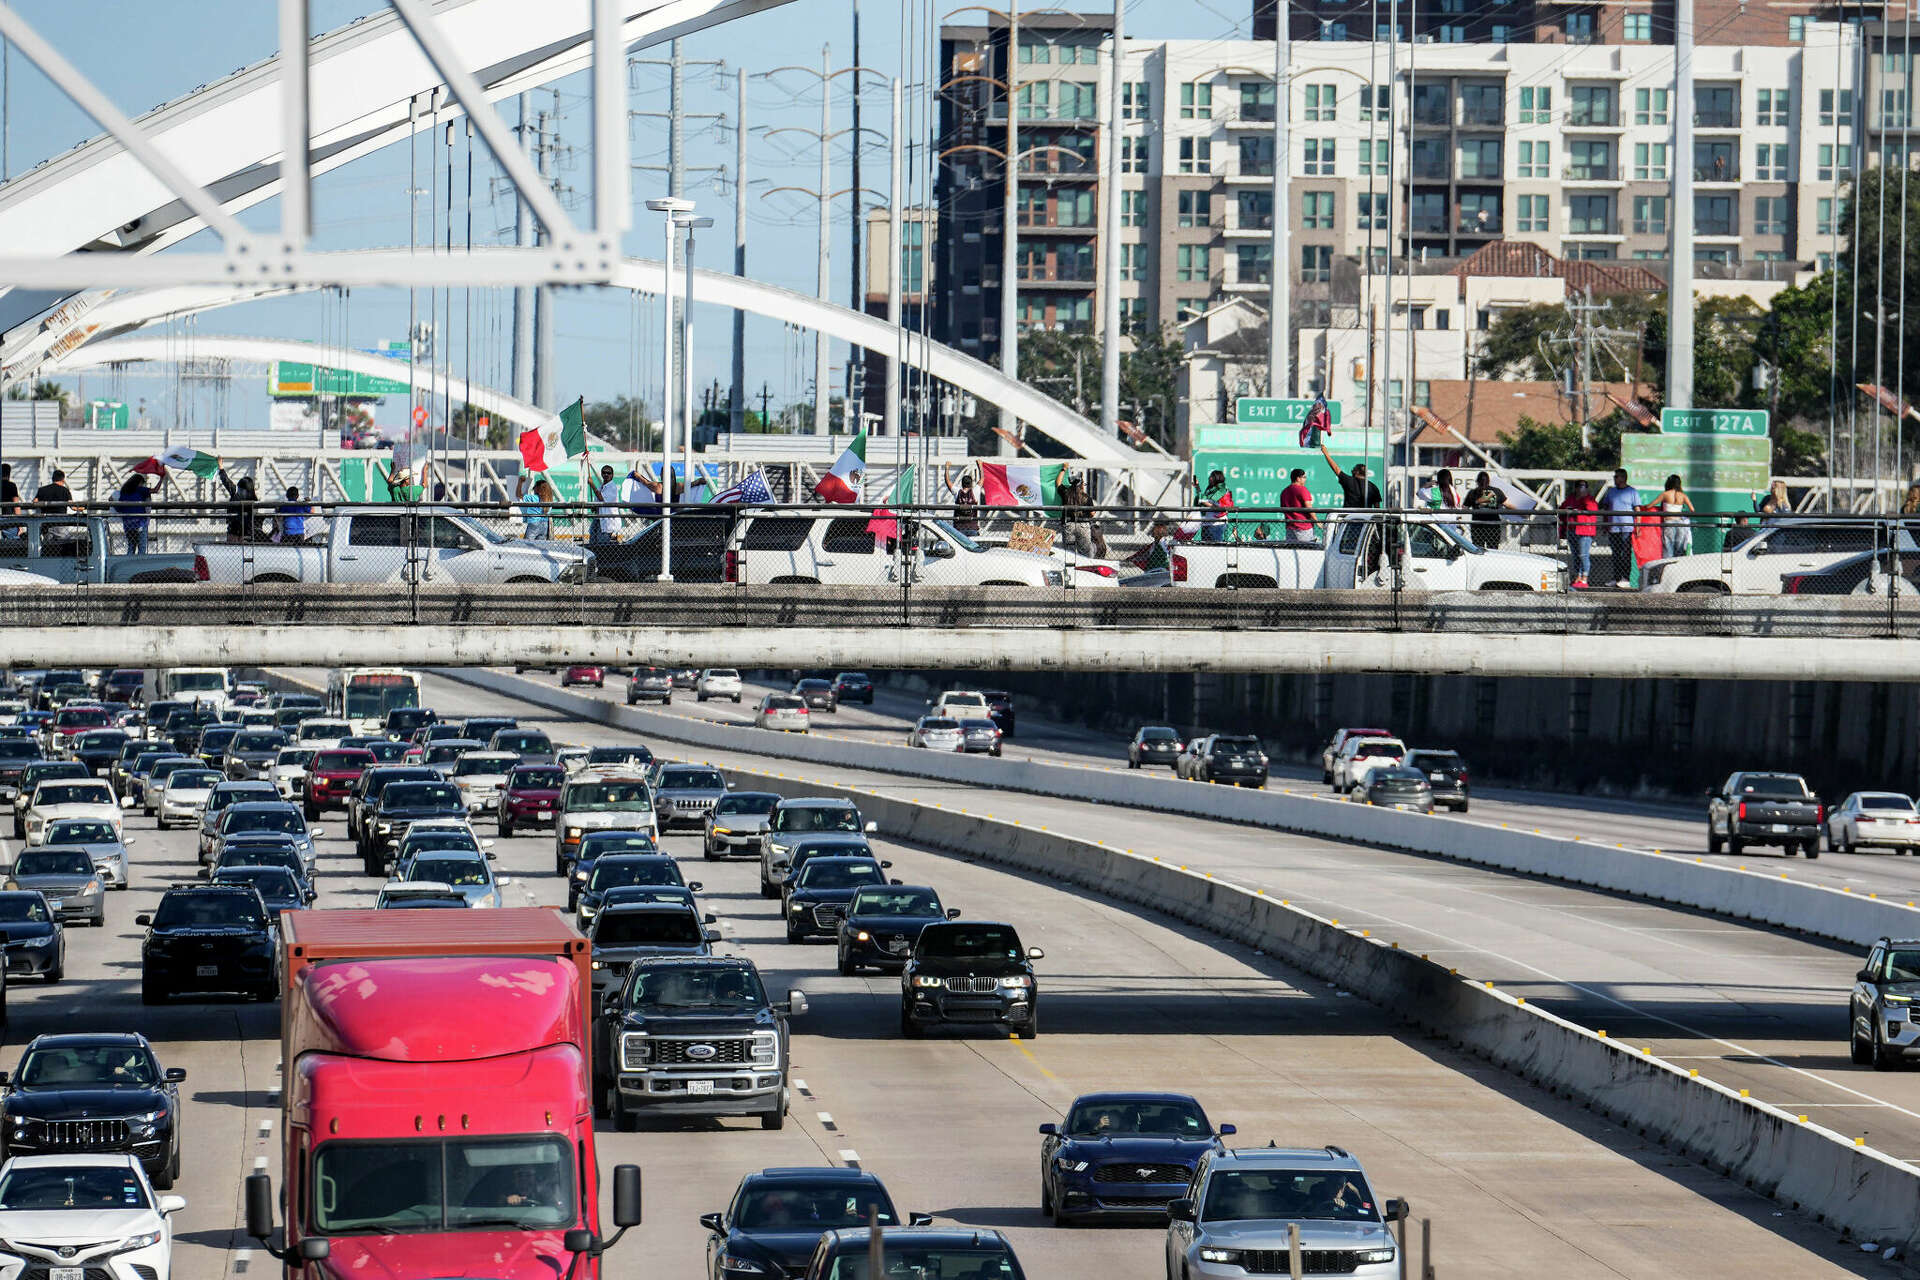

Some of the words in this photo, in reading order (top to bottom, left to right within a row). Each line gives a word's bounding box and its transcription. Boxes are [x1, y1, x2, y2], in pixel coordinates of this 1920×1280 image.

[1248, 405, 1277, 417] EXIT
[1673, 416, 1702, 427] EXIT
[1710, 415, 1755, 432] 127A
[1207, 461, 1316, 479] Richmod
